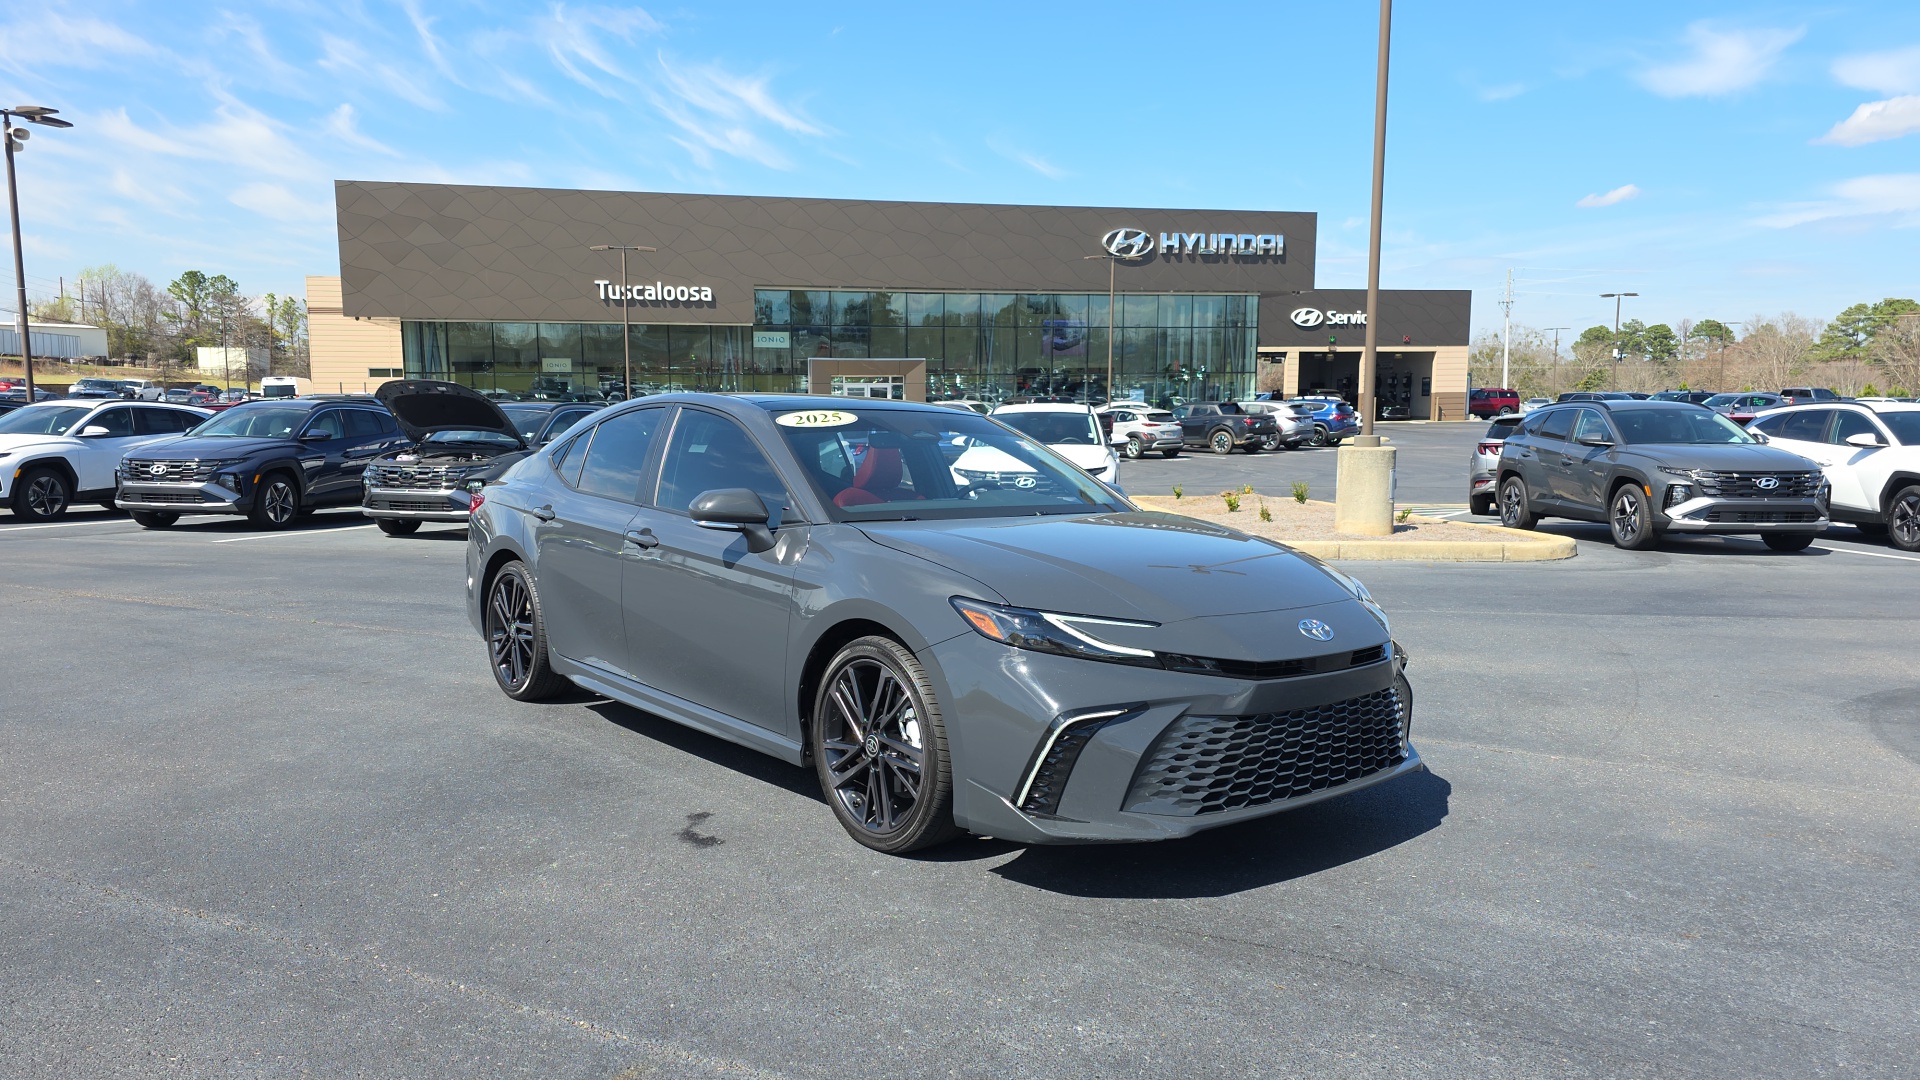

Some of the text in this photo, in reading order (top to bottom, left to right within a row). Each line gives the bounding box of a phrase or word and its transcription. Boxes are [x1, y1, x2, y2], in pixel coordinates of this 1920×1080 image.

[1160, 232, 1284, 256] HYUNDAI
[594, 280, 713, 301] Tuscaloosa
[1326, 310, 1368, 325] Servic
[793, 412, 842, 425] 2025
